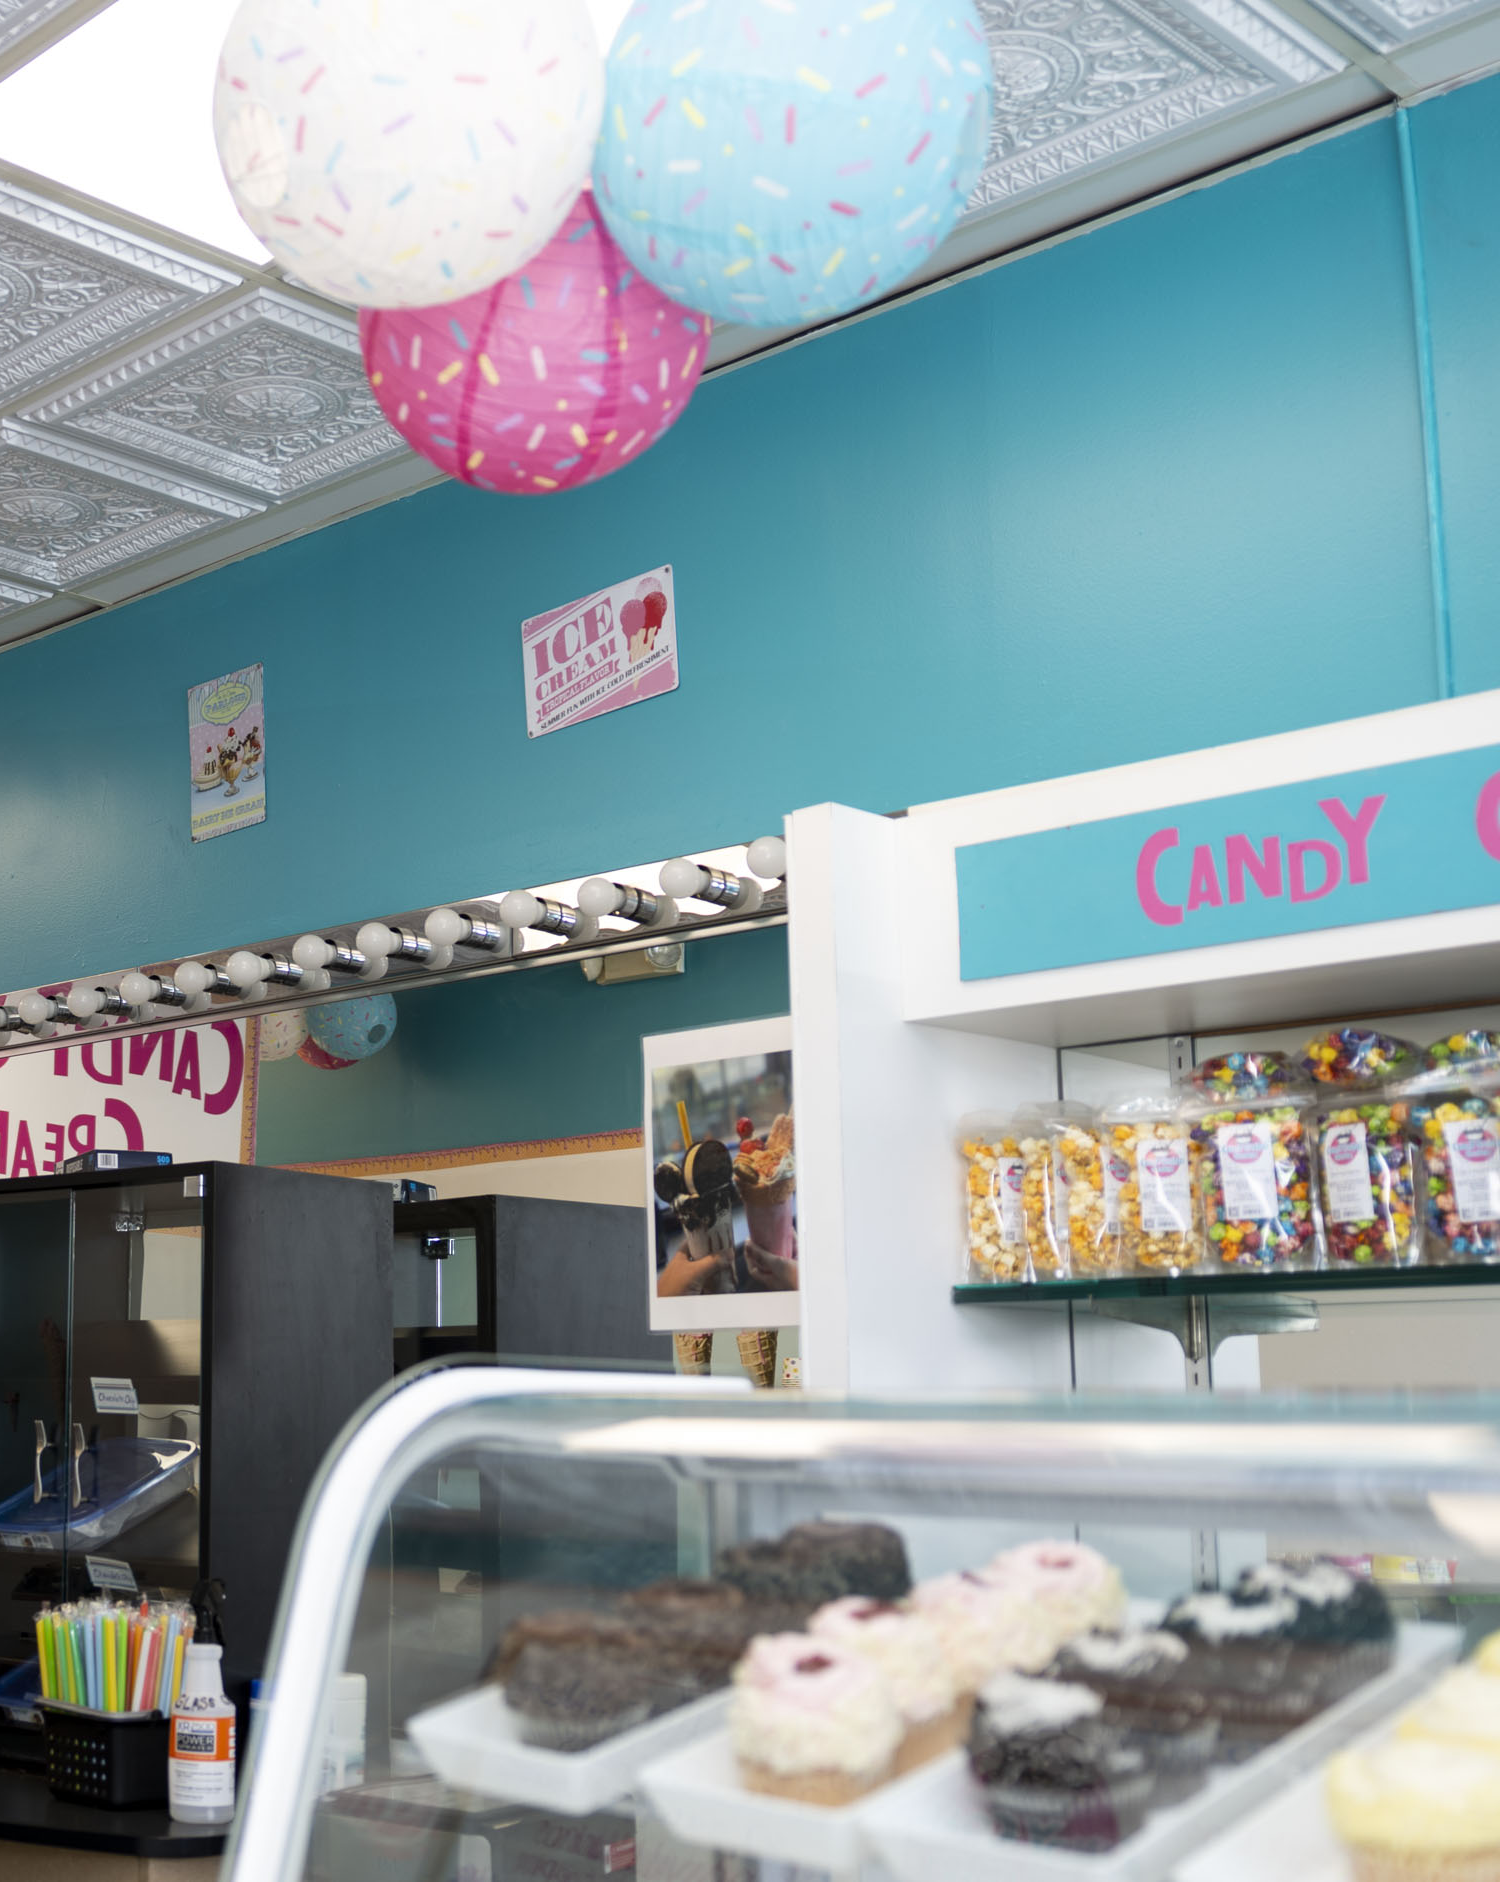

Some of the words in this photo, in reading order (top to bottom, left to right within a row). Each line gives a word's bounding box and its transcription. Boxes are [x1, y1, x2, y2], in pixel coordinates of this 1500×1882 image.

[532, 597, 614, 680] ICE
[536, 636, 617, 701] CREAM
[541, 710, 566, 730] SUMMER
[566, 703, 579, 717] FUN
[580, 693, 595, 707] WITH
[595, 685, 607, 697] ICE
[607, 676, 625, 690] COLD
[625, 645, 670, 678] REFRESHMENT
[1136, 794, 1387, 927] CANDY
[177, 1735, 214, 1745] POWER
